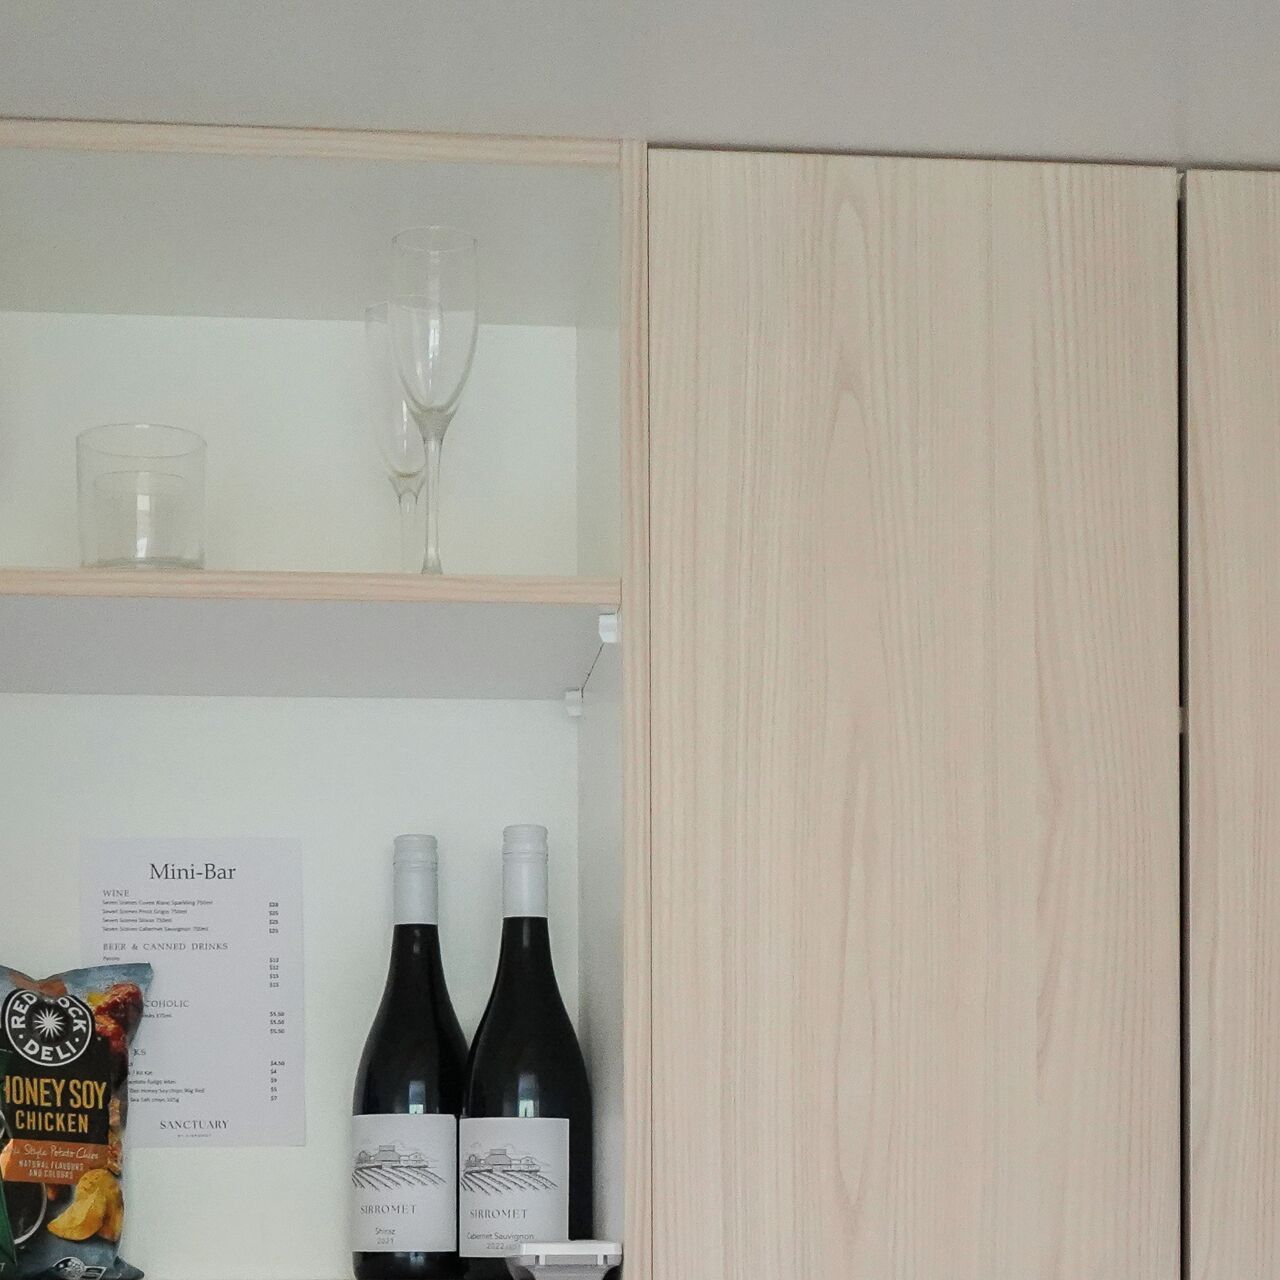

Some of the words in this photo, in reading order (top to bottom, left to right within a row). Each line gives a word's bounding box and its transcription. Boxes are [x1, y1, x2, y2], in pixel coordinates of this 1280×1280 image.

[149, 862, 236, 881] Mini-Bar
[102, 888, 130, 898] WINE
[102, 943, 127, 951] BEER
[131, 943, 139, 951] &
[143, 943, 187, 951] CANNED
[191, 943, 229, 951] DRINKS
[11, 993, 38, 1029] RED
[57, 996, 88, 1034] OCK
[23, 1038, 78, 1061] DELI
[69, 1078, 107, 1110] SOY
[15, 1109, 89, 1134] CHICKEN
[160, 1120, 229, 1130] SANCTUARY
[360, 1204, 417, 1215] SIRROMET
[469, 1209, 529, 1219] SIRROMET
[494, 1231, 535, 1242] Sauvignon
